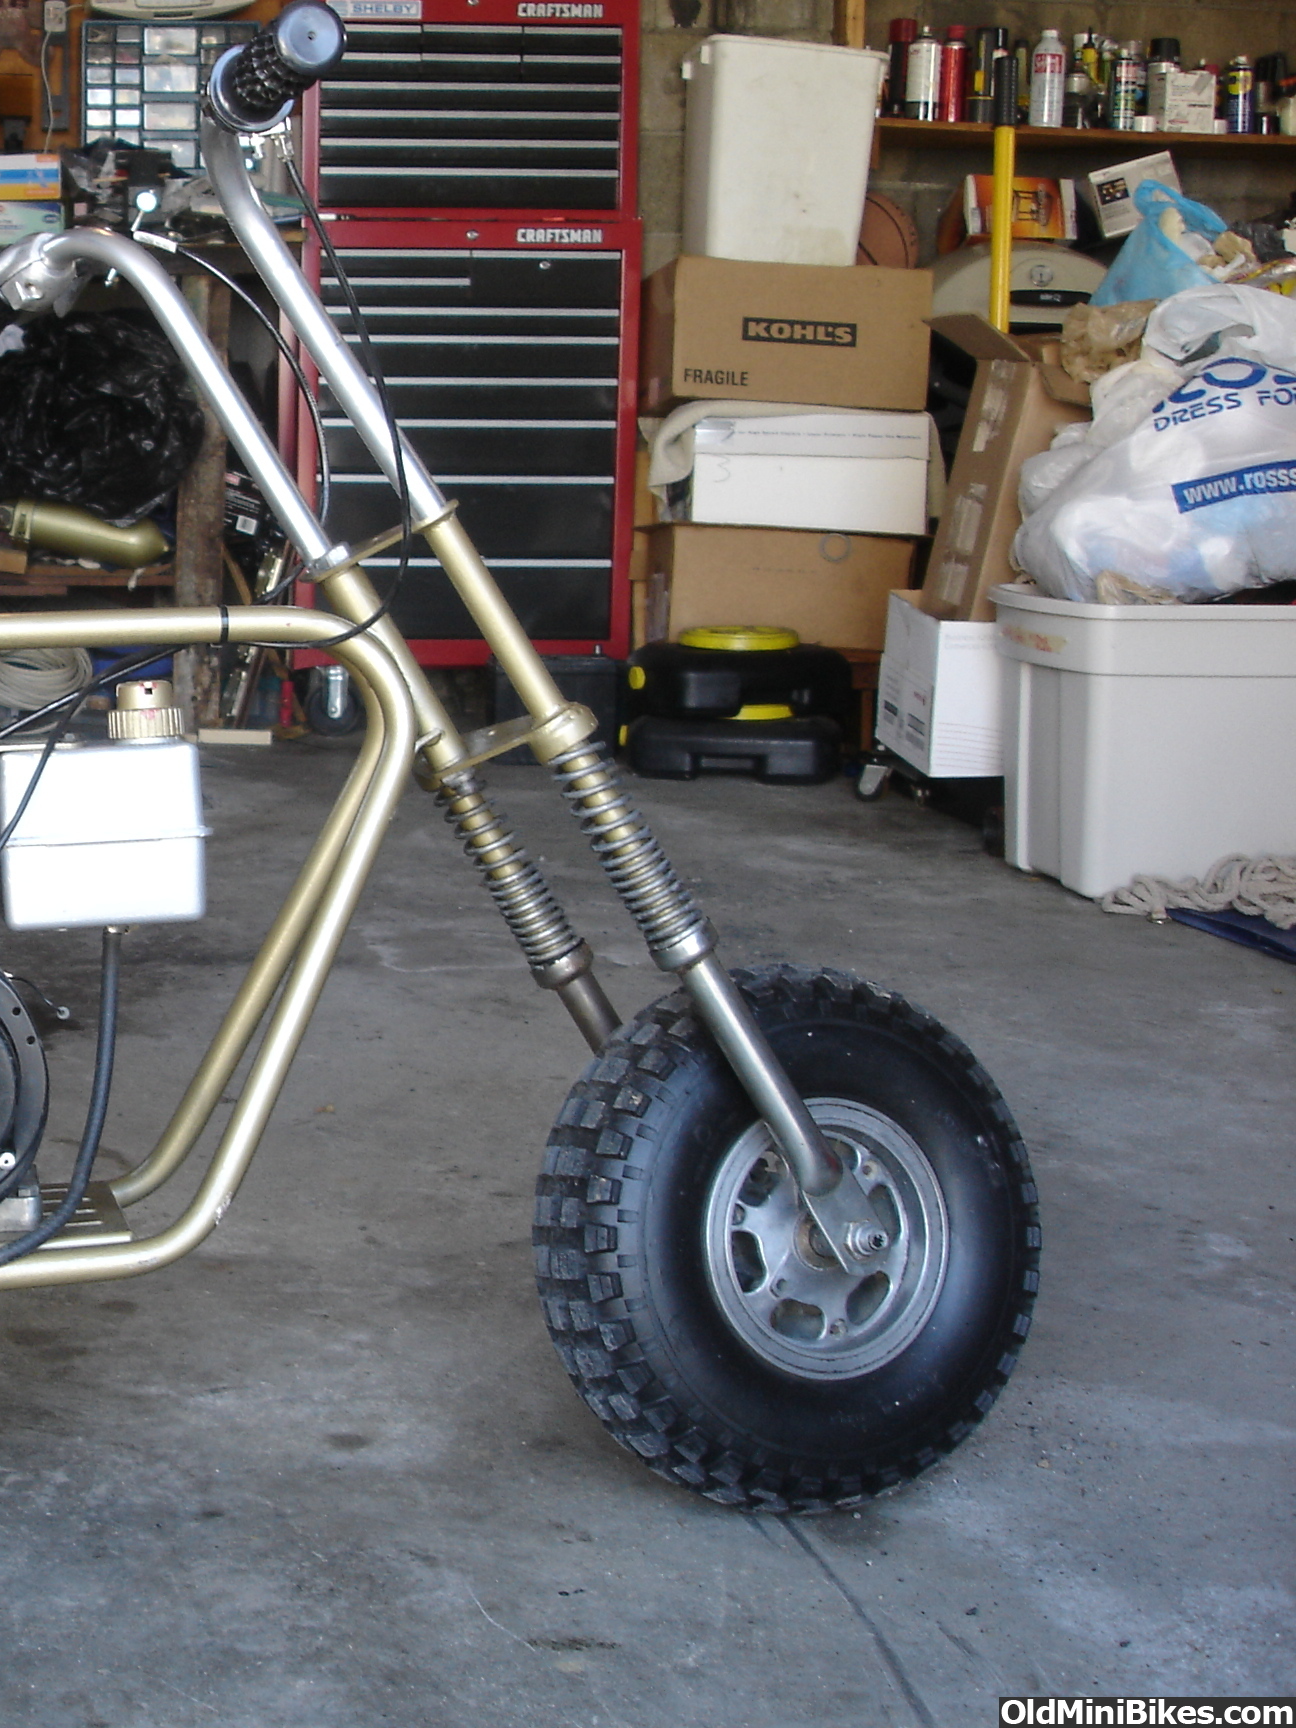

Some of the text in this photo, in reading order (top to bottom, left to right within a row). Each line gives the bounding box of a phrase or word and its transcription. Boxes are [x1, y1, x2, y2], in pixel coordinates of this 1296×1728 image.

[352, 3, 415, 14] SHELBY
[516, 2, 604, 18] CRAFTSMAN
[516, 228, 603, 243] CRAFTSMAN
[746, 320, 854, 345] KOHL'S
[683, 367, 749, 387] FRAGILE
[1153, 392, 1243, 432] DRESS
